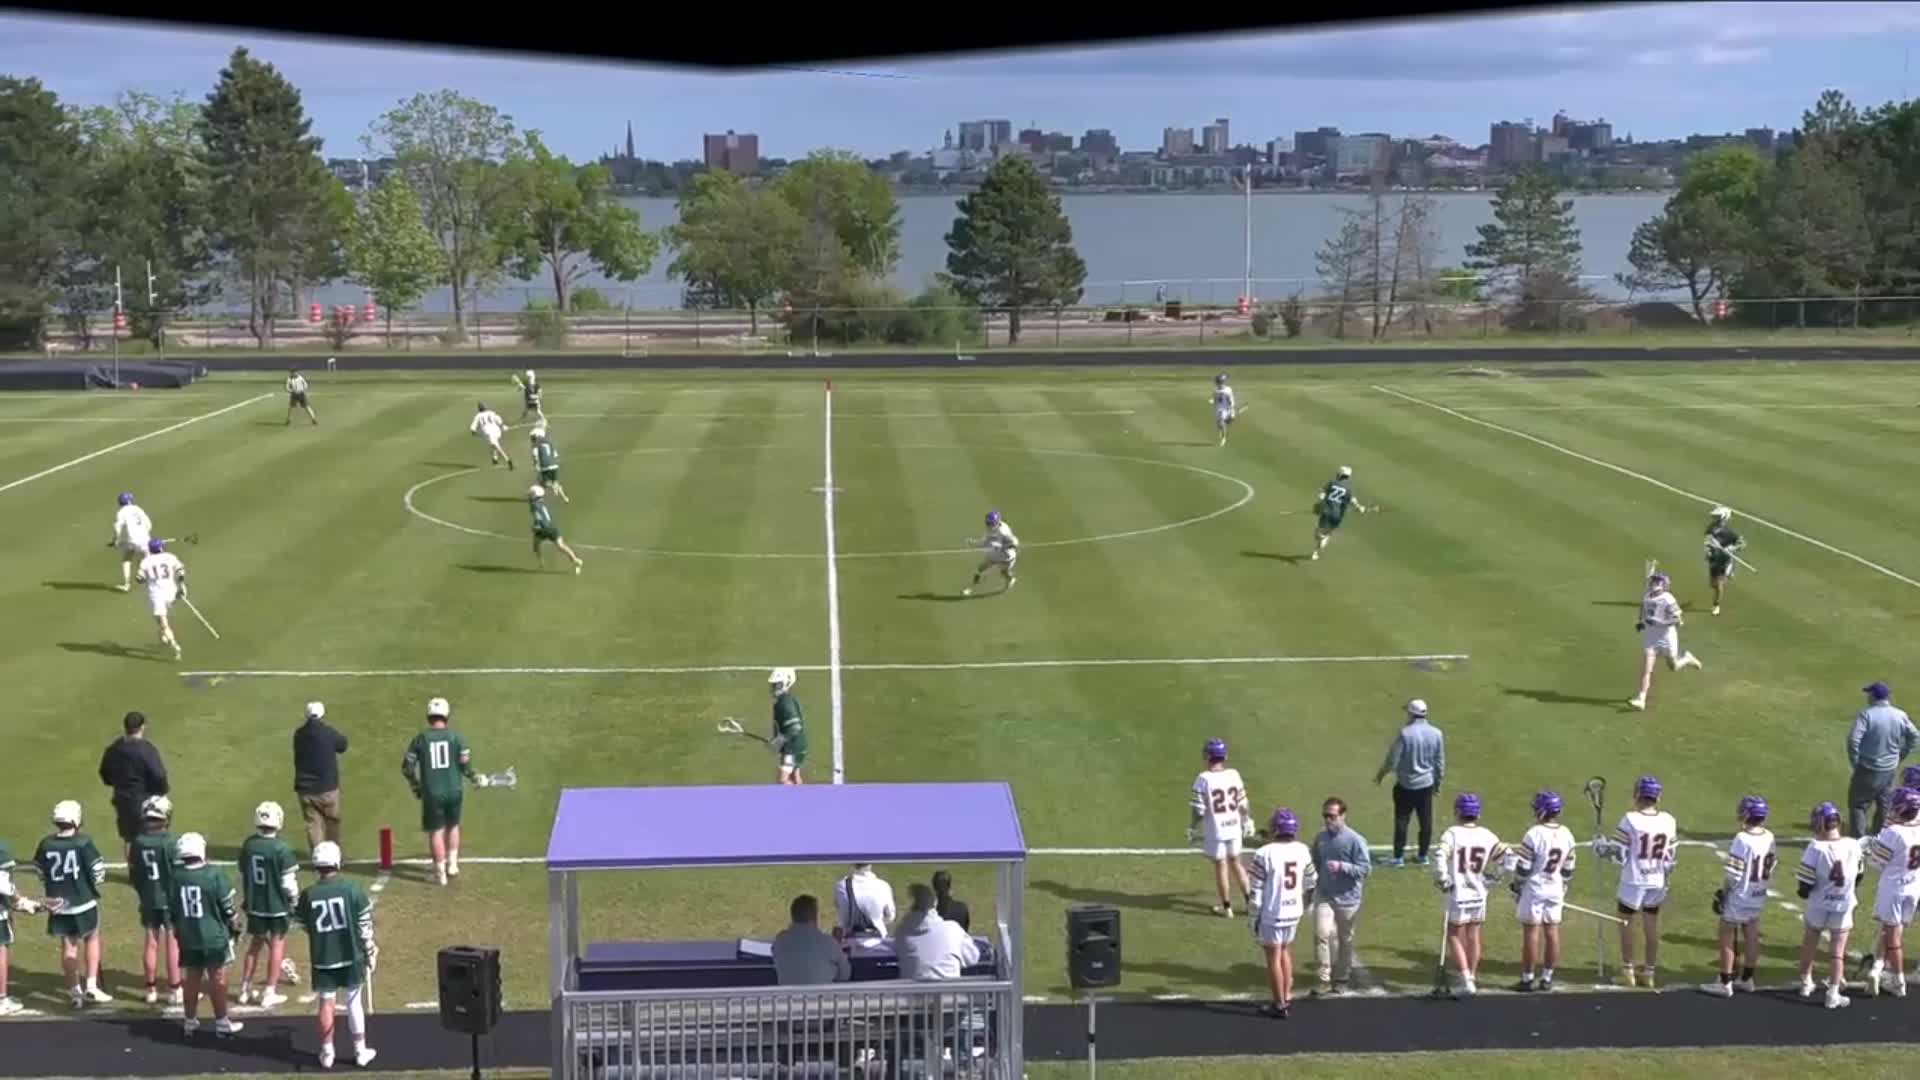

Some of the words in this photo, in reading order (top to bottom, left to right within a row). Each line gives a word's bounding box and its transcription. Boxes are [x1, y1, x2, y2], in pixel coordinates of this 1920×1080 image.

[1328, 485, 1347, 504] 22
[152, 563, 170, 580] 13
[429, 740, 450, 769] 10
[1212, 787, 1239, 814] 23
[1457, 846, 1486, 874] 15
[1639, 833, 1667, 860] 12
[46, 849, 80, 881] 24
[142, 849, 160, 880] 5
[252, 855, 267, 885] 6
[1544, 848, 1562, 874] 2
[1828, 860, 1845, 887] 4
[1284, 862, 1298, 890] 5
[180, 886, 204, 918] 18
[311, 896, 347, 933] 20
